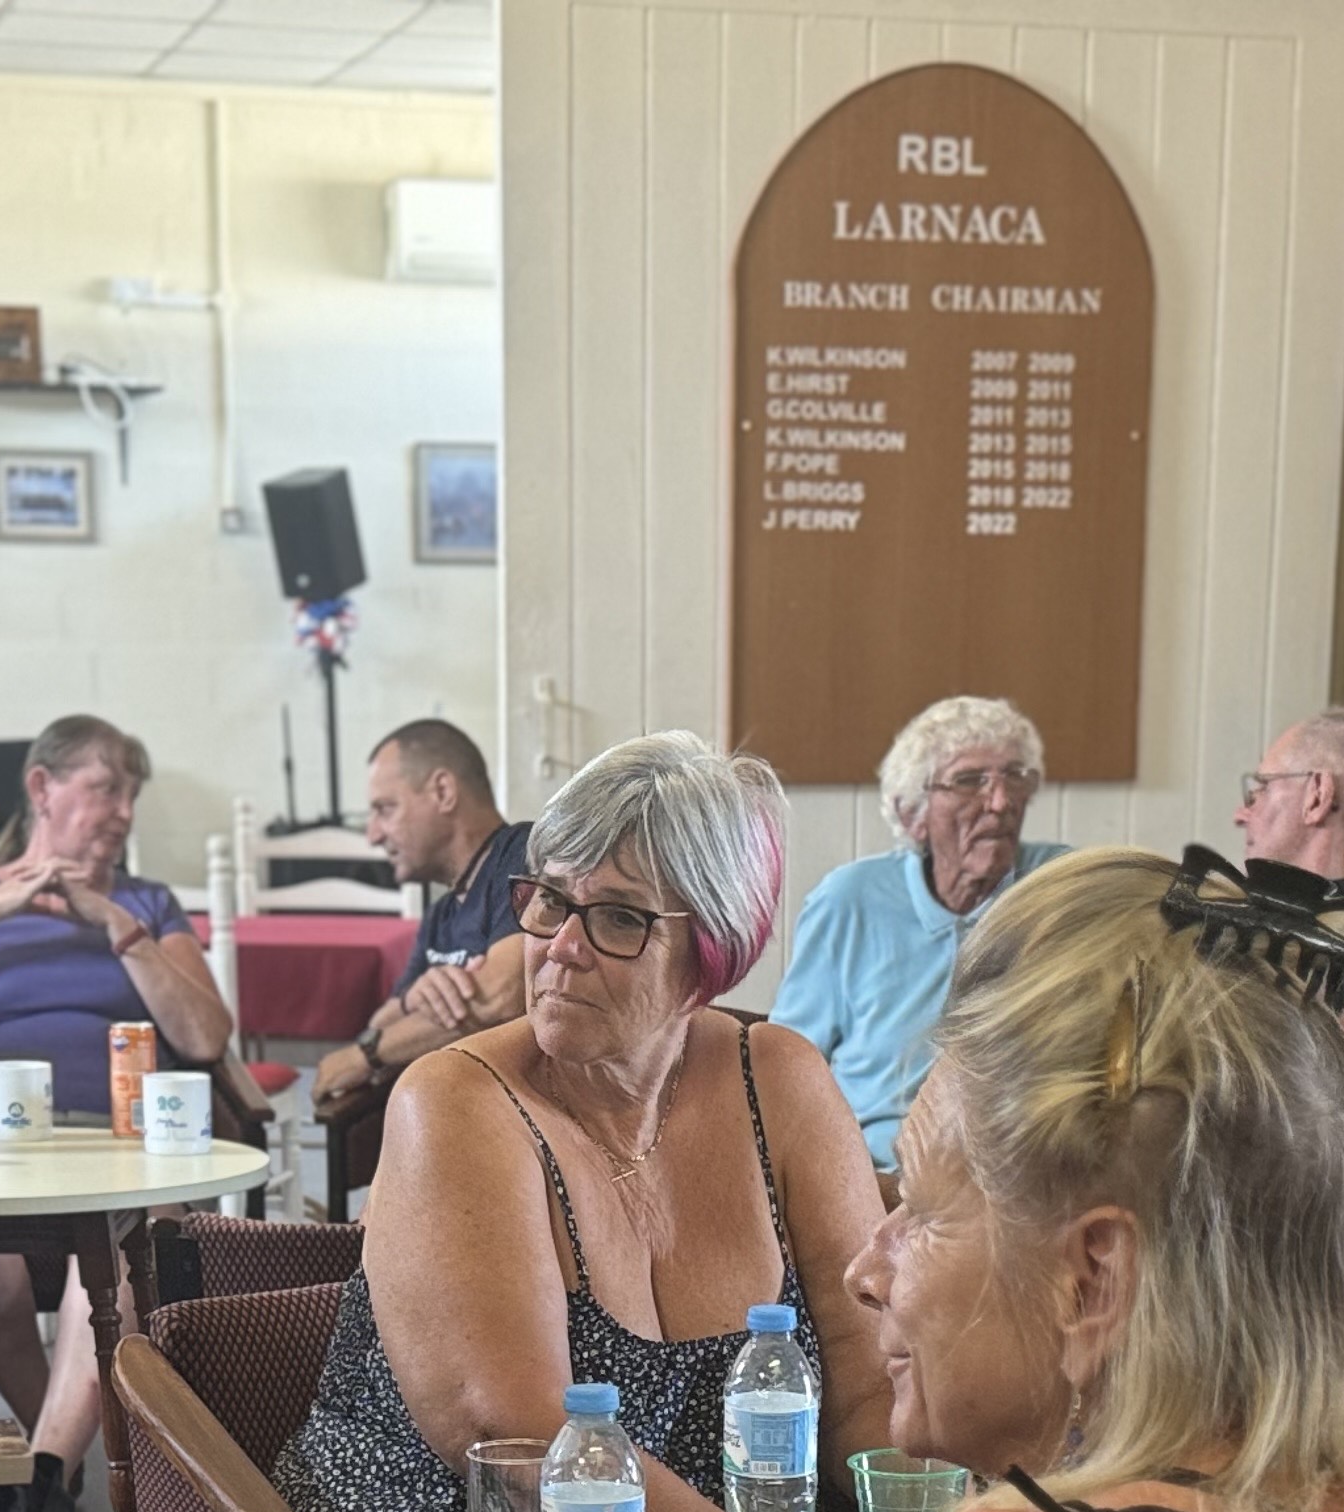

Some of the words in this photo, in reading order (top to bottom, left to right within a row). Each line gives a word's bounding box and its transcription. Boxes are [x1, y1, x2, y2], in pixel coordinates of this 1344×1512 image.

[898, 133, 989, 177] RBL
[833, 201, 1046, 246] LARNACA
[783, 280, 910, 311] BRANCH
[930, 283, 1103, 315] CHAIRMAN
[781, 507, 861, 533] PERRY
